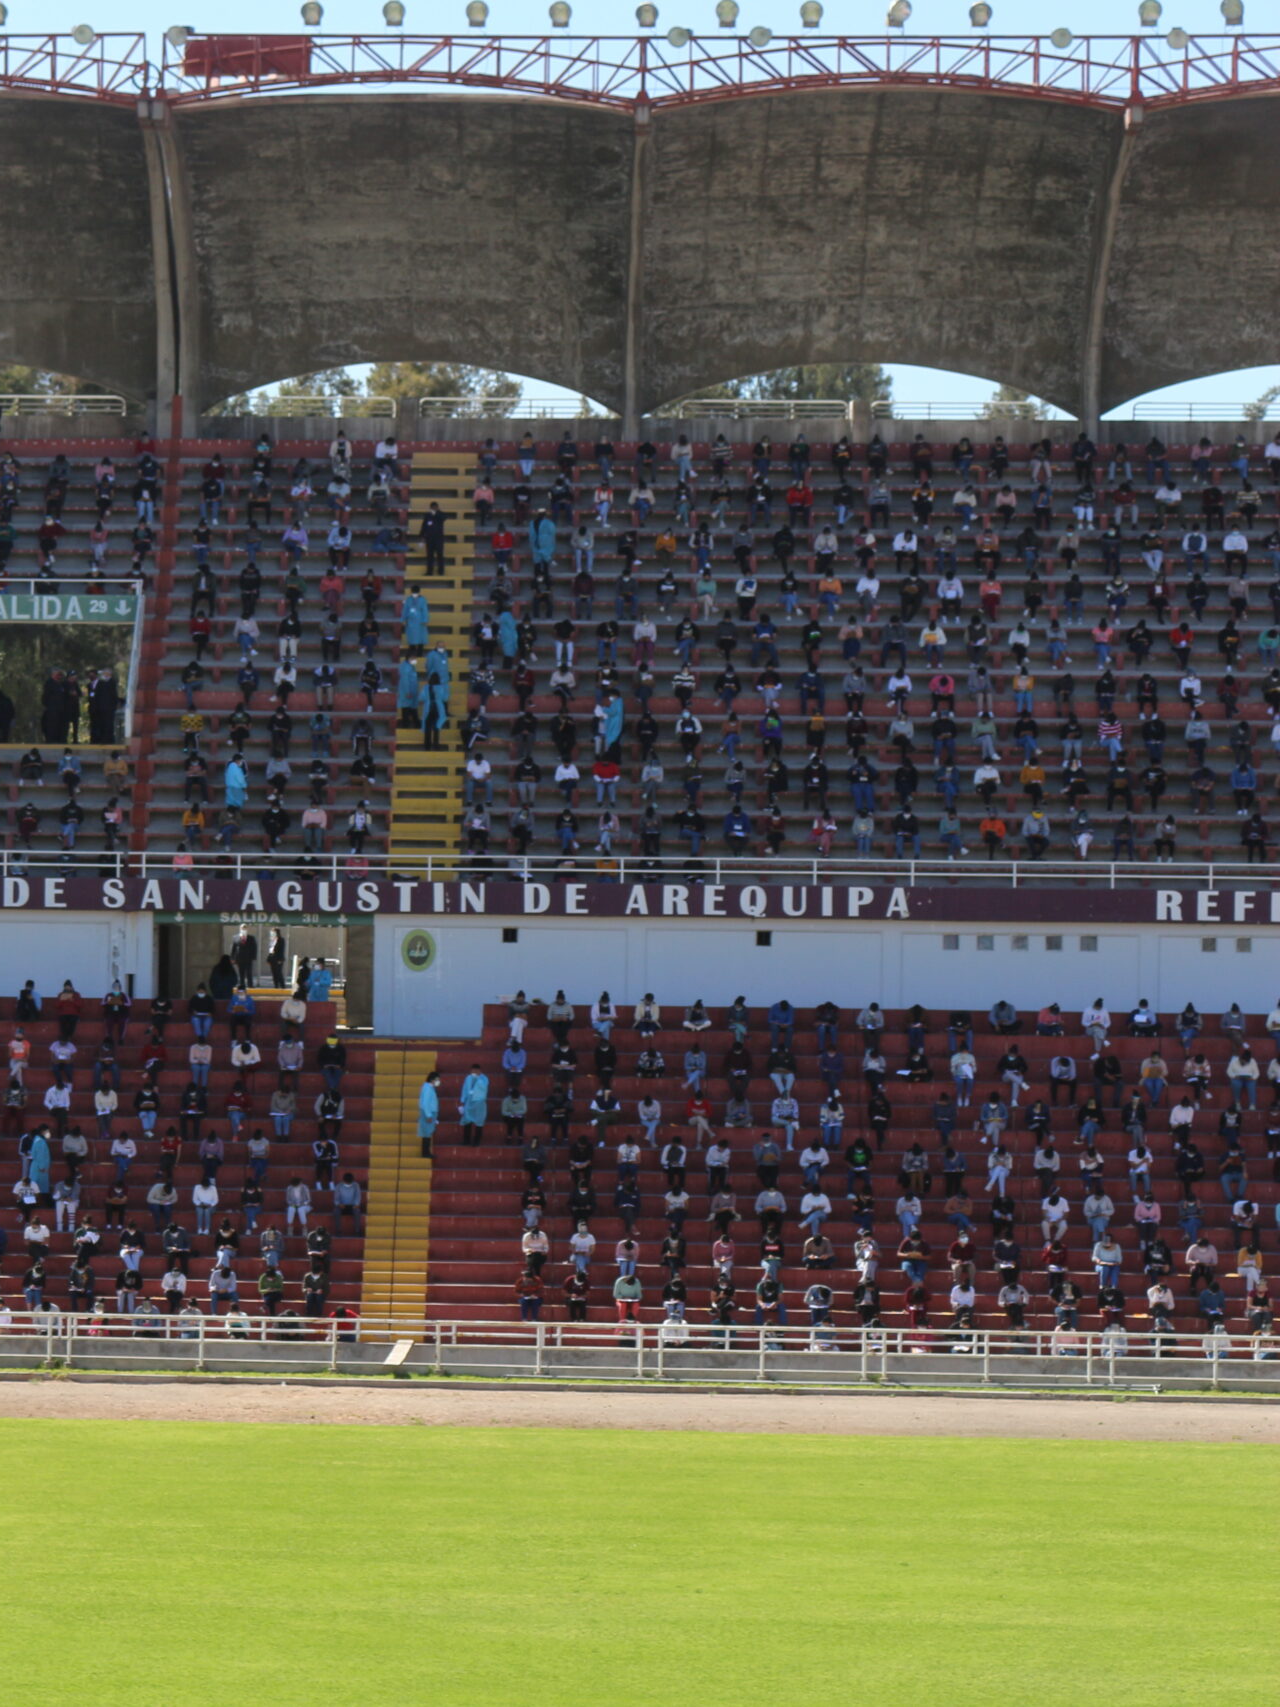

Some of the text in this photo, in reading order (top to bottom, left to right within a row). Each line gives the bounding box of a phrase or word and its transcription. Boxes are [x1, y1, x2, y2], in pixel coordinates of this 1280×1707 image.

[89, 599, 108, 614] 29
[3, 877, 67, 908] DE
[102, 878, 205, 910] SAN
[240, 880, 486, 914] AGUSTIN
[523, 883, 589, 914] DE
[625, 884, 910, 918] AREQUIPA
[220, 911, 280, 924] SALIDA
